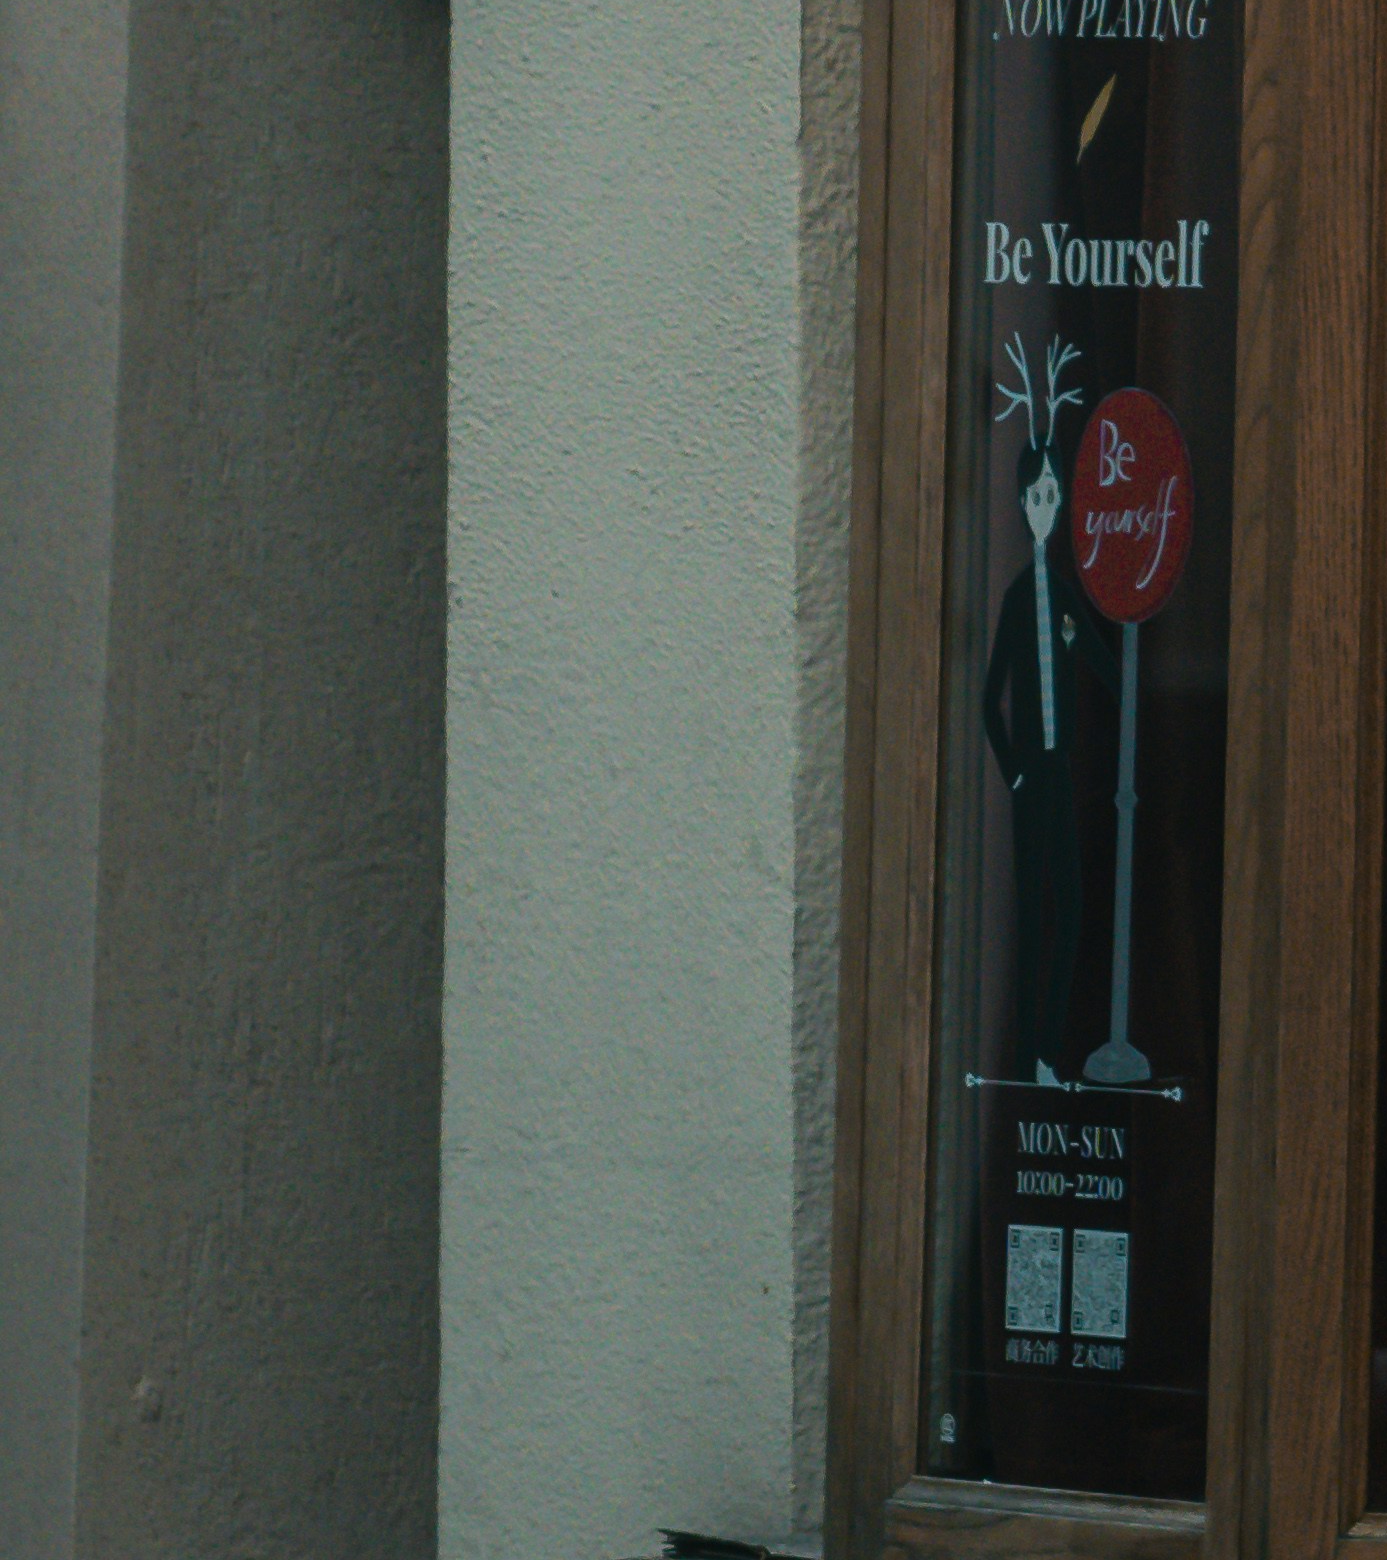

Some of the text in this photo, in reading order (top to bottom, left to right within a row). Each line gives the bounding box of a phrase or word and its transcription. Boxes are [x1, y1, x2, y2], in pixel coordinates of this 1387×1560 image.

[983, 219, 1211, 288] Be Yourself
[1099, 419, 1136, 487] Be
[1016, 1120, 1125, 1160] MON-SUN
[1016, 1170, 1124, 1201] 10:00-22:00
